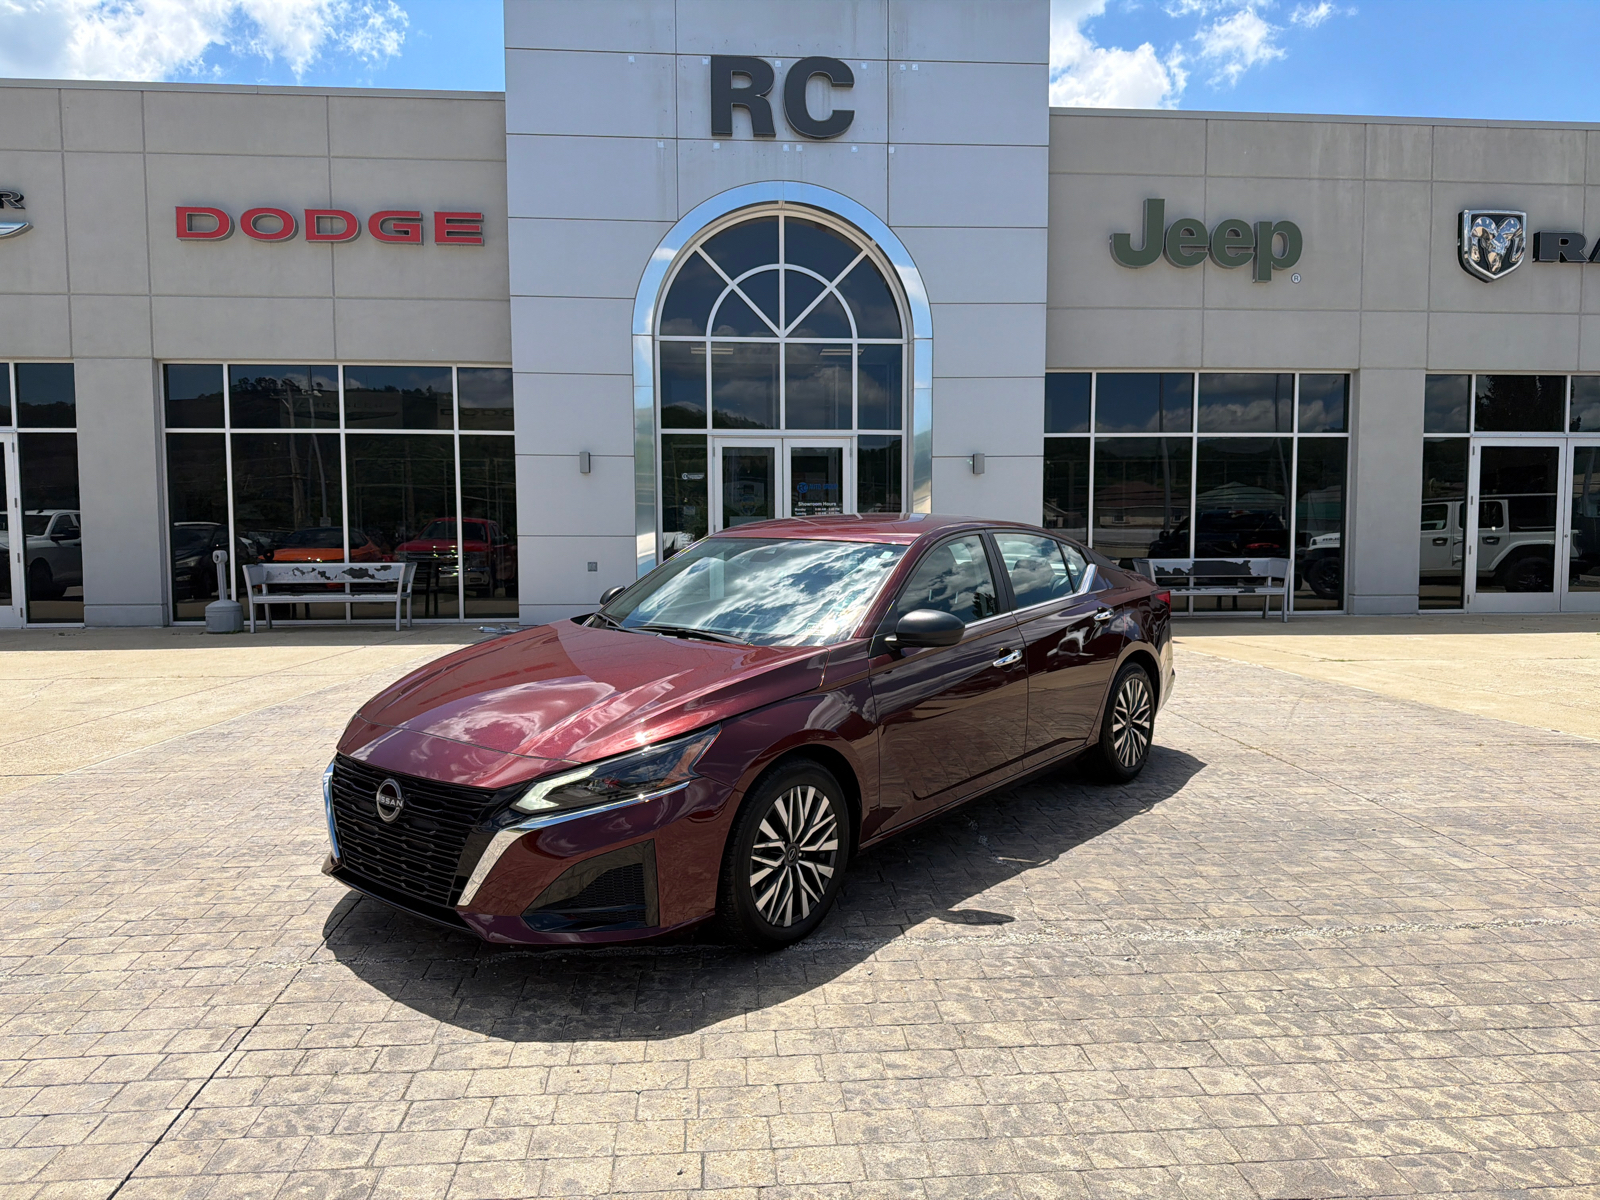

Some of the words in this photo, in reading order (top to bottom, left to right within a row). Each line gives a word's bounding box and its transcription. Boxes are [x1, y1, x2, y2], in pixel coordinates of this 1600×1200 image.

[710, 55, 855, 140] RC
[175, 206, 485, 245] DODGE
[1109, 198, 1303, 283] Jeep
[1533, 231, 1600, 263] R
